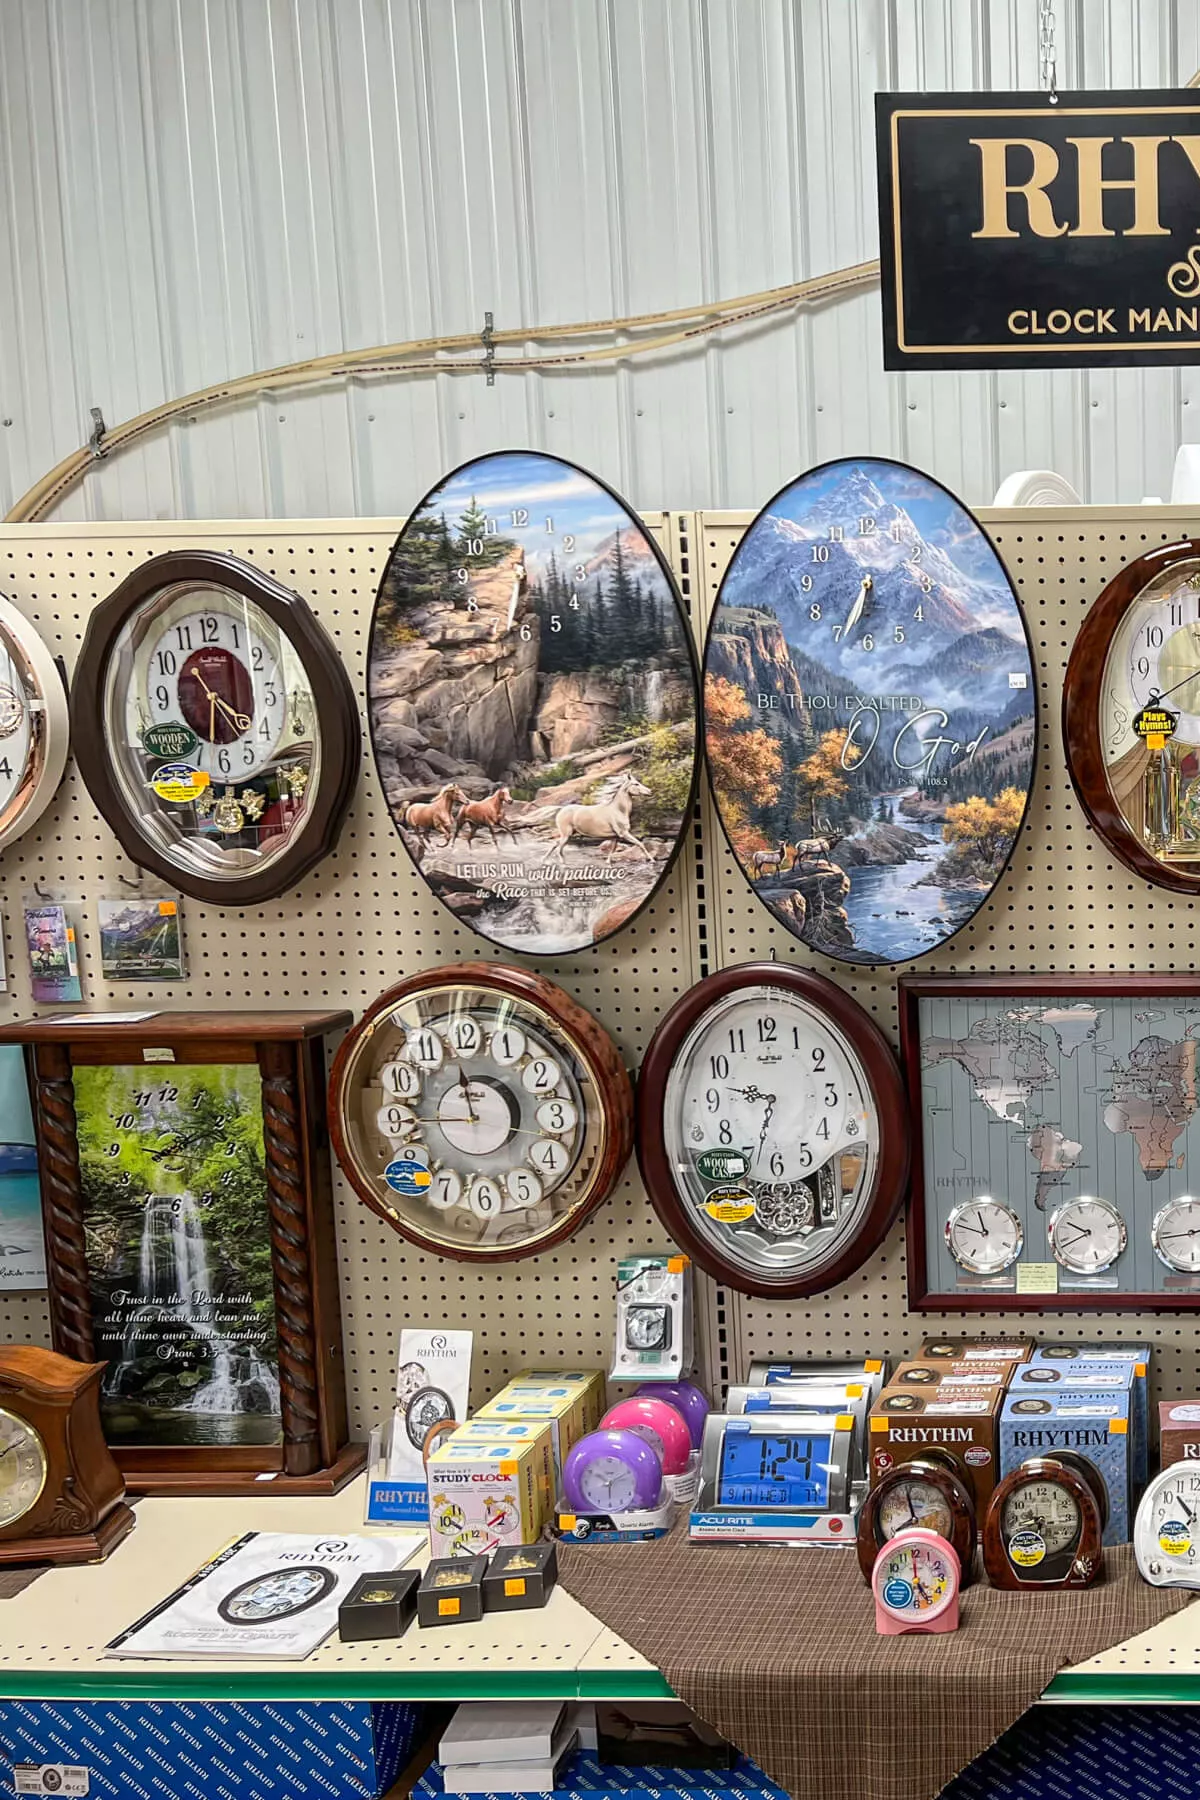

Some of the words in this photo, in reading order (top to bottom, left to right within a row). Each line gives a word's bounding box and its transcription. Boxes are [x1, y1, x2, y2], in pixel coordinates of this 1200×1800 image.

[1007, 308, 1116, 336] CLOCK
[200, 618, 219, 642] 12
[1143, 711, 1166, 722] Plays
[1139, 720, 1171, 731] Hymns!
[149, 732, 191, 745] WOODEN
[893, 709, 989, 773] God
[160, 744, 184, 755] CASE
[456, 864, 477, 879] LET
[481, 864, 497, 878] US
[500, 863, 524, 878] RUN
[528, 865, 561, 882] with
[562, 866, 627, 885] patience
[476, 888, 491, 899] the
[491, 881, 530, 901] Race
[572, 887, 598, 897] BEFORE
[455, 1023, 476, 1050] 12
[758, 1017, 777, 1042] 12
[728, 1029, 746, 1053] 11
[110, 1289, 148, 1306] Trust
[151, 1295, 163, 1304] in
[167, 1292, 186, 1305] the
[191, 1289, 223, 1306] Lord
[227, 1291, 253, 1304] with
[104, 1310, 122, 1322] all
[157, 1310, 187, 1322] heart
[189, 1310, 211, 1322] and
[214, 1310, 238, 1322] lean
[242, 1310, 262, 1322] not
[102, 1329, 127, 1341] unto
[131, 1328, 159, 1341] thine
[162, 1332, 188, 1341] own
[190, 1328, 271, 1343] understanding.
[156, 1344, 195, 1360] Prov.
[417, 1349, 457, 1358] RHYTHM
[888, 1427, 974, 1443] RHYTHM
[1013, 1430, 1109, 1447] RHYTHM
[759, 1438, 813, 1482] 1:24
[433, 1474, 470, 1483] STUDY
[471, 1473, 512, 1482] CLOCK
[1190, 1478, 1200, 1491] 12
[375, 1489, 428, 1504] RHYTH
[278, 1552, 361, 1563] RHYTHM
[263, 1704, 296, 1733] RHYTHM
[302, 1738, 335, 1768] RHYTHM
